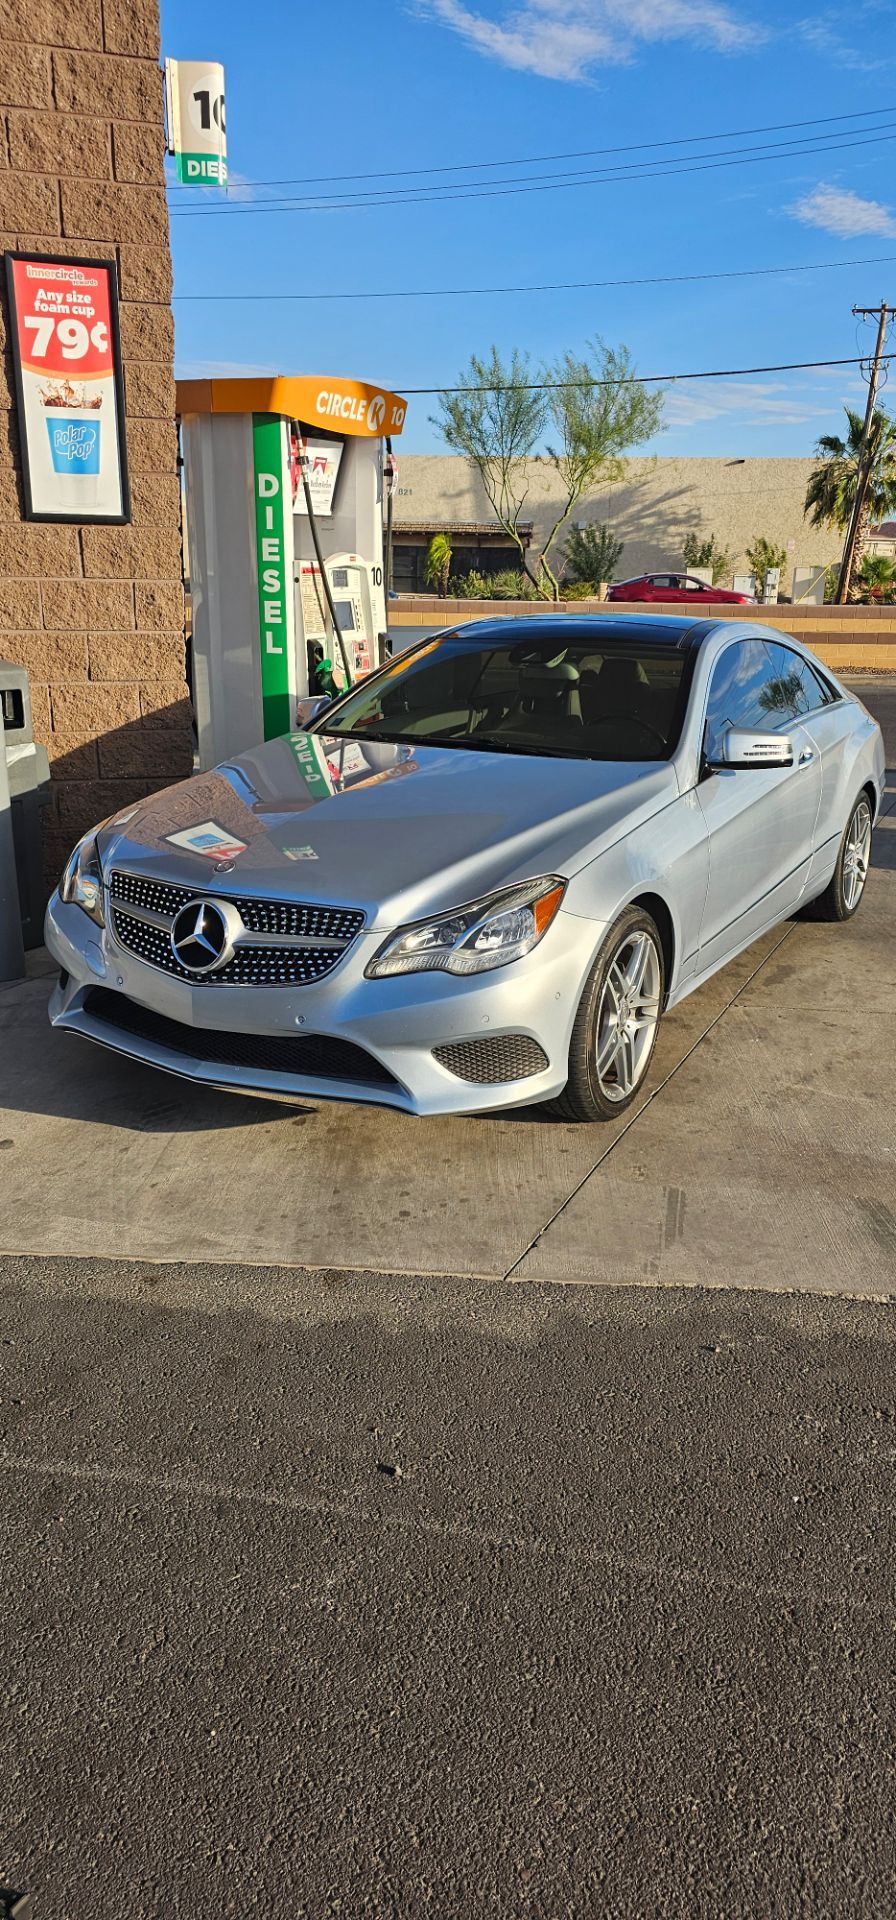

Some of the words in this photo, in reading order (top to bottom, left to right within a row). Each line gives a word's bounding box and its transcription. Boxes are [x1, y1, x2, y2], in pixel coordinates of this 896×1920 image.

[26, 265, 84, 281] innercircle
[72, 279, 98, 287] rewards
[36, 288, 63, 304] Any
[66, 290, 92, 304] size
[34, 300, 70, 313] foam
[72, 305, 95, 318] cup
[24, 316, 109, 360] 79¢
[316, 390, 367, 422] CIRCLE
[368, 397, 385, 431] K
[391, 406, 405, 426] 10
[54, 424, 86, 447] Polar
[68, 442, 93, 460] Pop
[258, 473, 283, 655] DIESEL
[371, 566, 382, 587] 10
